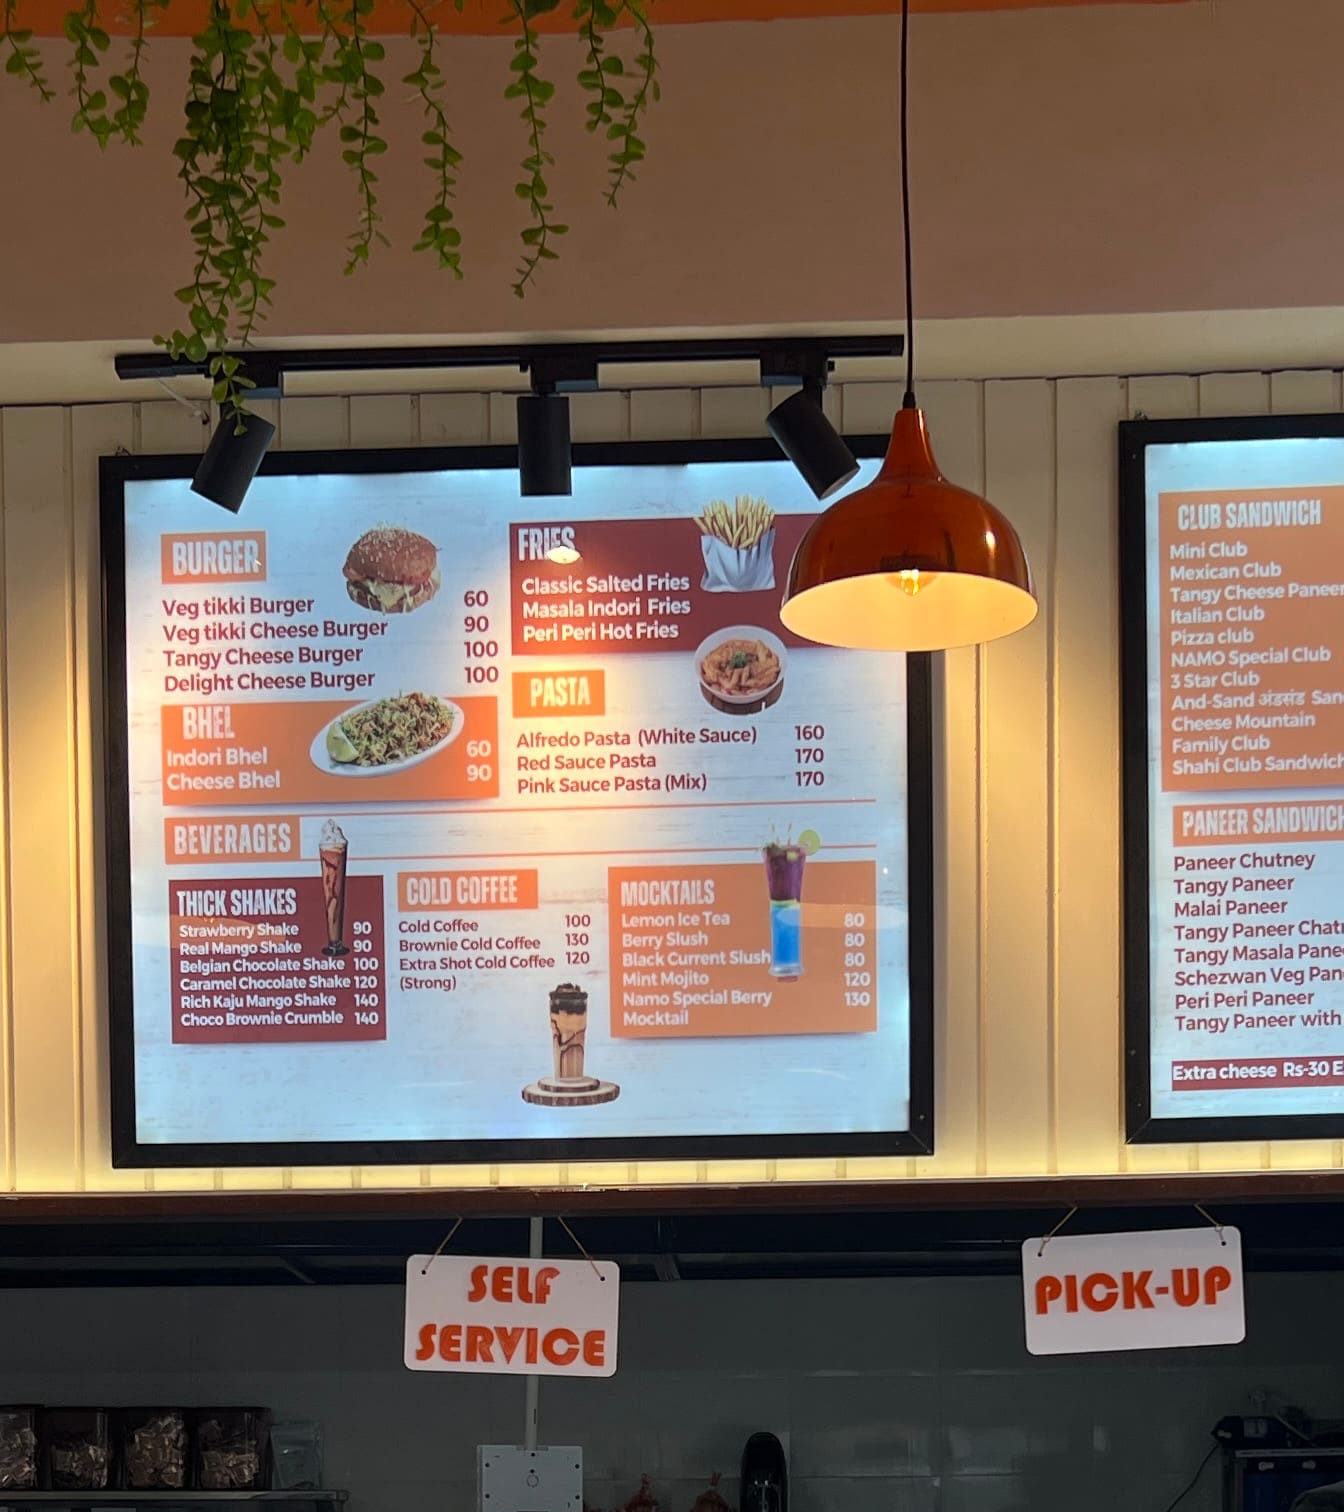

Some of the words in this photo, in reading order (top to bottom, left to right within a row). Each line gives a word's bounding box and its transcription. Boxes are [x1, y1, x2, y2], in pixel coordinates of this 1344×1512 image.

[1177, 503, 1222, 531] CLUB
[1225, 499, 1321, 529] SANDWICH
[172, 539, 259, 576] BURGER
[1169, 542, 1206, 559] Mini
[1208, 540, 1248, 558] Club
[521, 575, 583, 595] Classic
[586, 573, 643, 593] Salted
[647, 572, 690, 592] Fries
[161, 599, 199, 620] Veg
[203, 595, 246, 616] tikki
[249, 597, 315, 618] Burger
[463, 590, 489, 608] 60
[1171, 650, 1226, 667] NAMO
[1228, 647, 1289, 669] Special
[1291, 645, 1332, 663] Club
[164, 672, 234, 696] Delight
[237, 672, 307, 690] Cheese
[310, 671, 376, 692] Burger
[464, 666, 499, 684] 100
[530, 676, 591, 707] PASTA
[1171, 691, 1255, 711] And-Sand
[182, 705, 235, 740] BHEL
[167, 747, 222, 767] Indori
[225, 746, 268, 765] Bhel
[466, 739, 492, 758] 60
[517, 754, 551, 771] Red
[554, 754, 606, 770] Sauce
[609, 753, 657, 769] Pasta
[794, 747, 825, 764] 170
[1182, 808, 1249, 837] PANEER
[174, 822, 291, 855] BEVERAGES
[1174, 856, 1237, 872] Paneer
[1239, 852, 1316, 871] Chutney
[176, 889, 228, 917] THICK
[230, 888, 297, 916] SHAKES
[406, 877, 452, 906] COLD
[456, 875, 518, 905] COFFEE
[620, 879, 715, 907] MOCKTAILS
[621, 913, 675, 928] Lemon
[678, 912, 701, 927] Ice
[702, 911, 731, 926] Tea
[843, 912, 865, 928] 80
[1174, 898, 1221, 918] Malai
[1225, 900, 1289, 916] Paneer
[398, 919, 431, 934] Cold
[433, 918, 479, 933] Coffee
[565, 914, 591, 928] 100
[179, 941, 210, 956] Real
[211, 941, 258, 957] Mango
[259, 939, 302, 954] Shake
[353, 939, 372, 953] 90
[622, 971, 658, 987] Mint
[660, 969, 710, 989] Mojito
[844, 971, 872, 987] 120
[467, 1264, 561, 1305] SELF
[1034, 1265, 1233, 1316] PICK-UP
[415, 1322, 607, 1368] SERVICE
